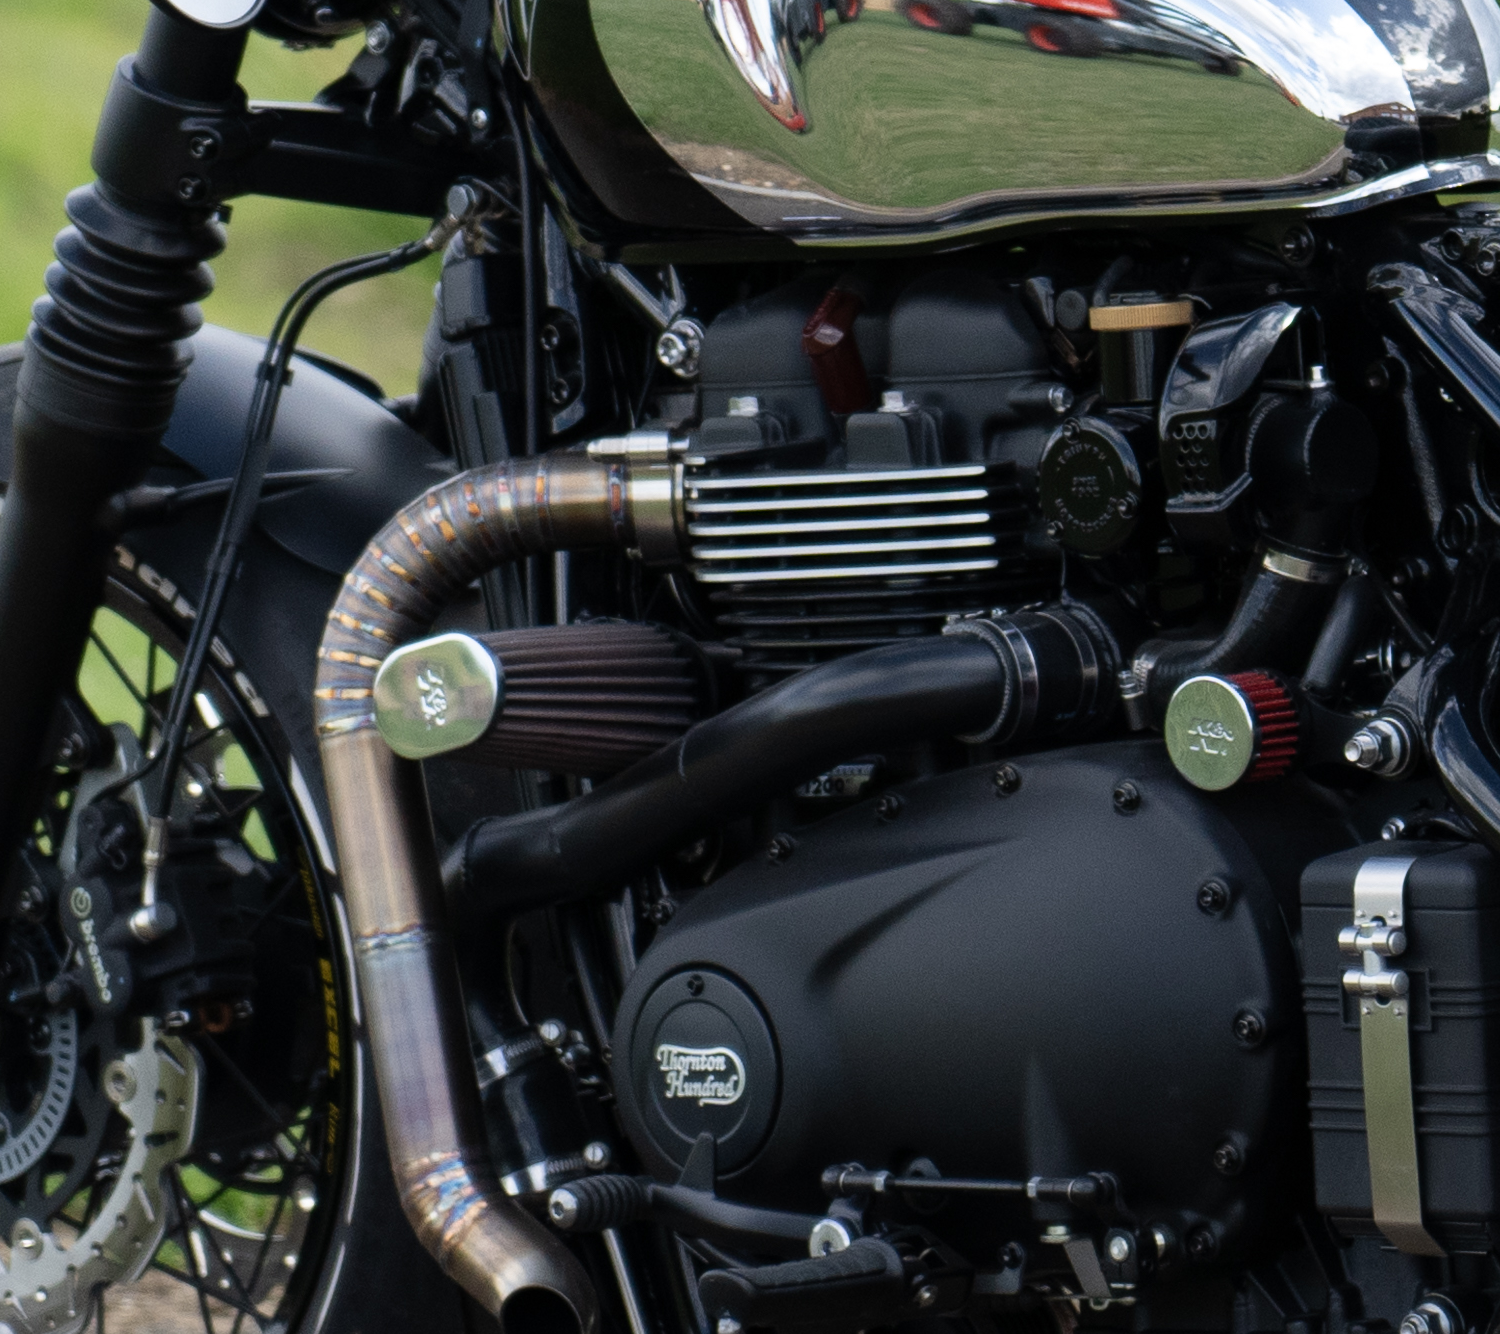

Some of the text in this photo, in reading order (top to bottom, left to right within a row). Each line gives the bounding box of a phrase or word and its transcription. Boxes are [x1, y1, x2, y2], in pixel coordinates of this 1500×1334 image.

[80, 918, 112, 1004] brembo
[656, 1044, 727, 1071] Thornton
[665, 1071, 738, 1098] Hundred
